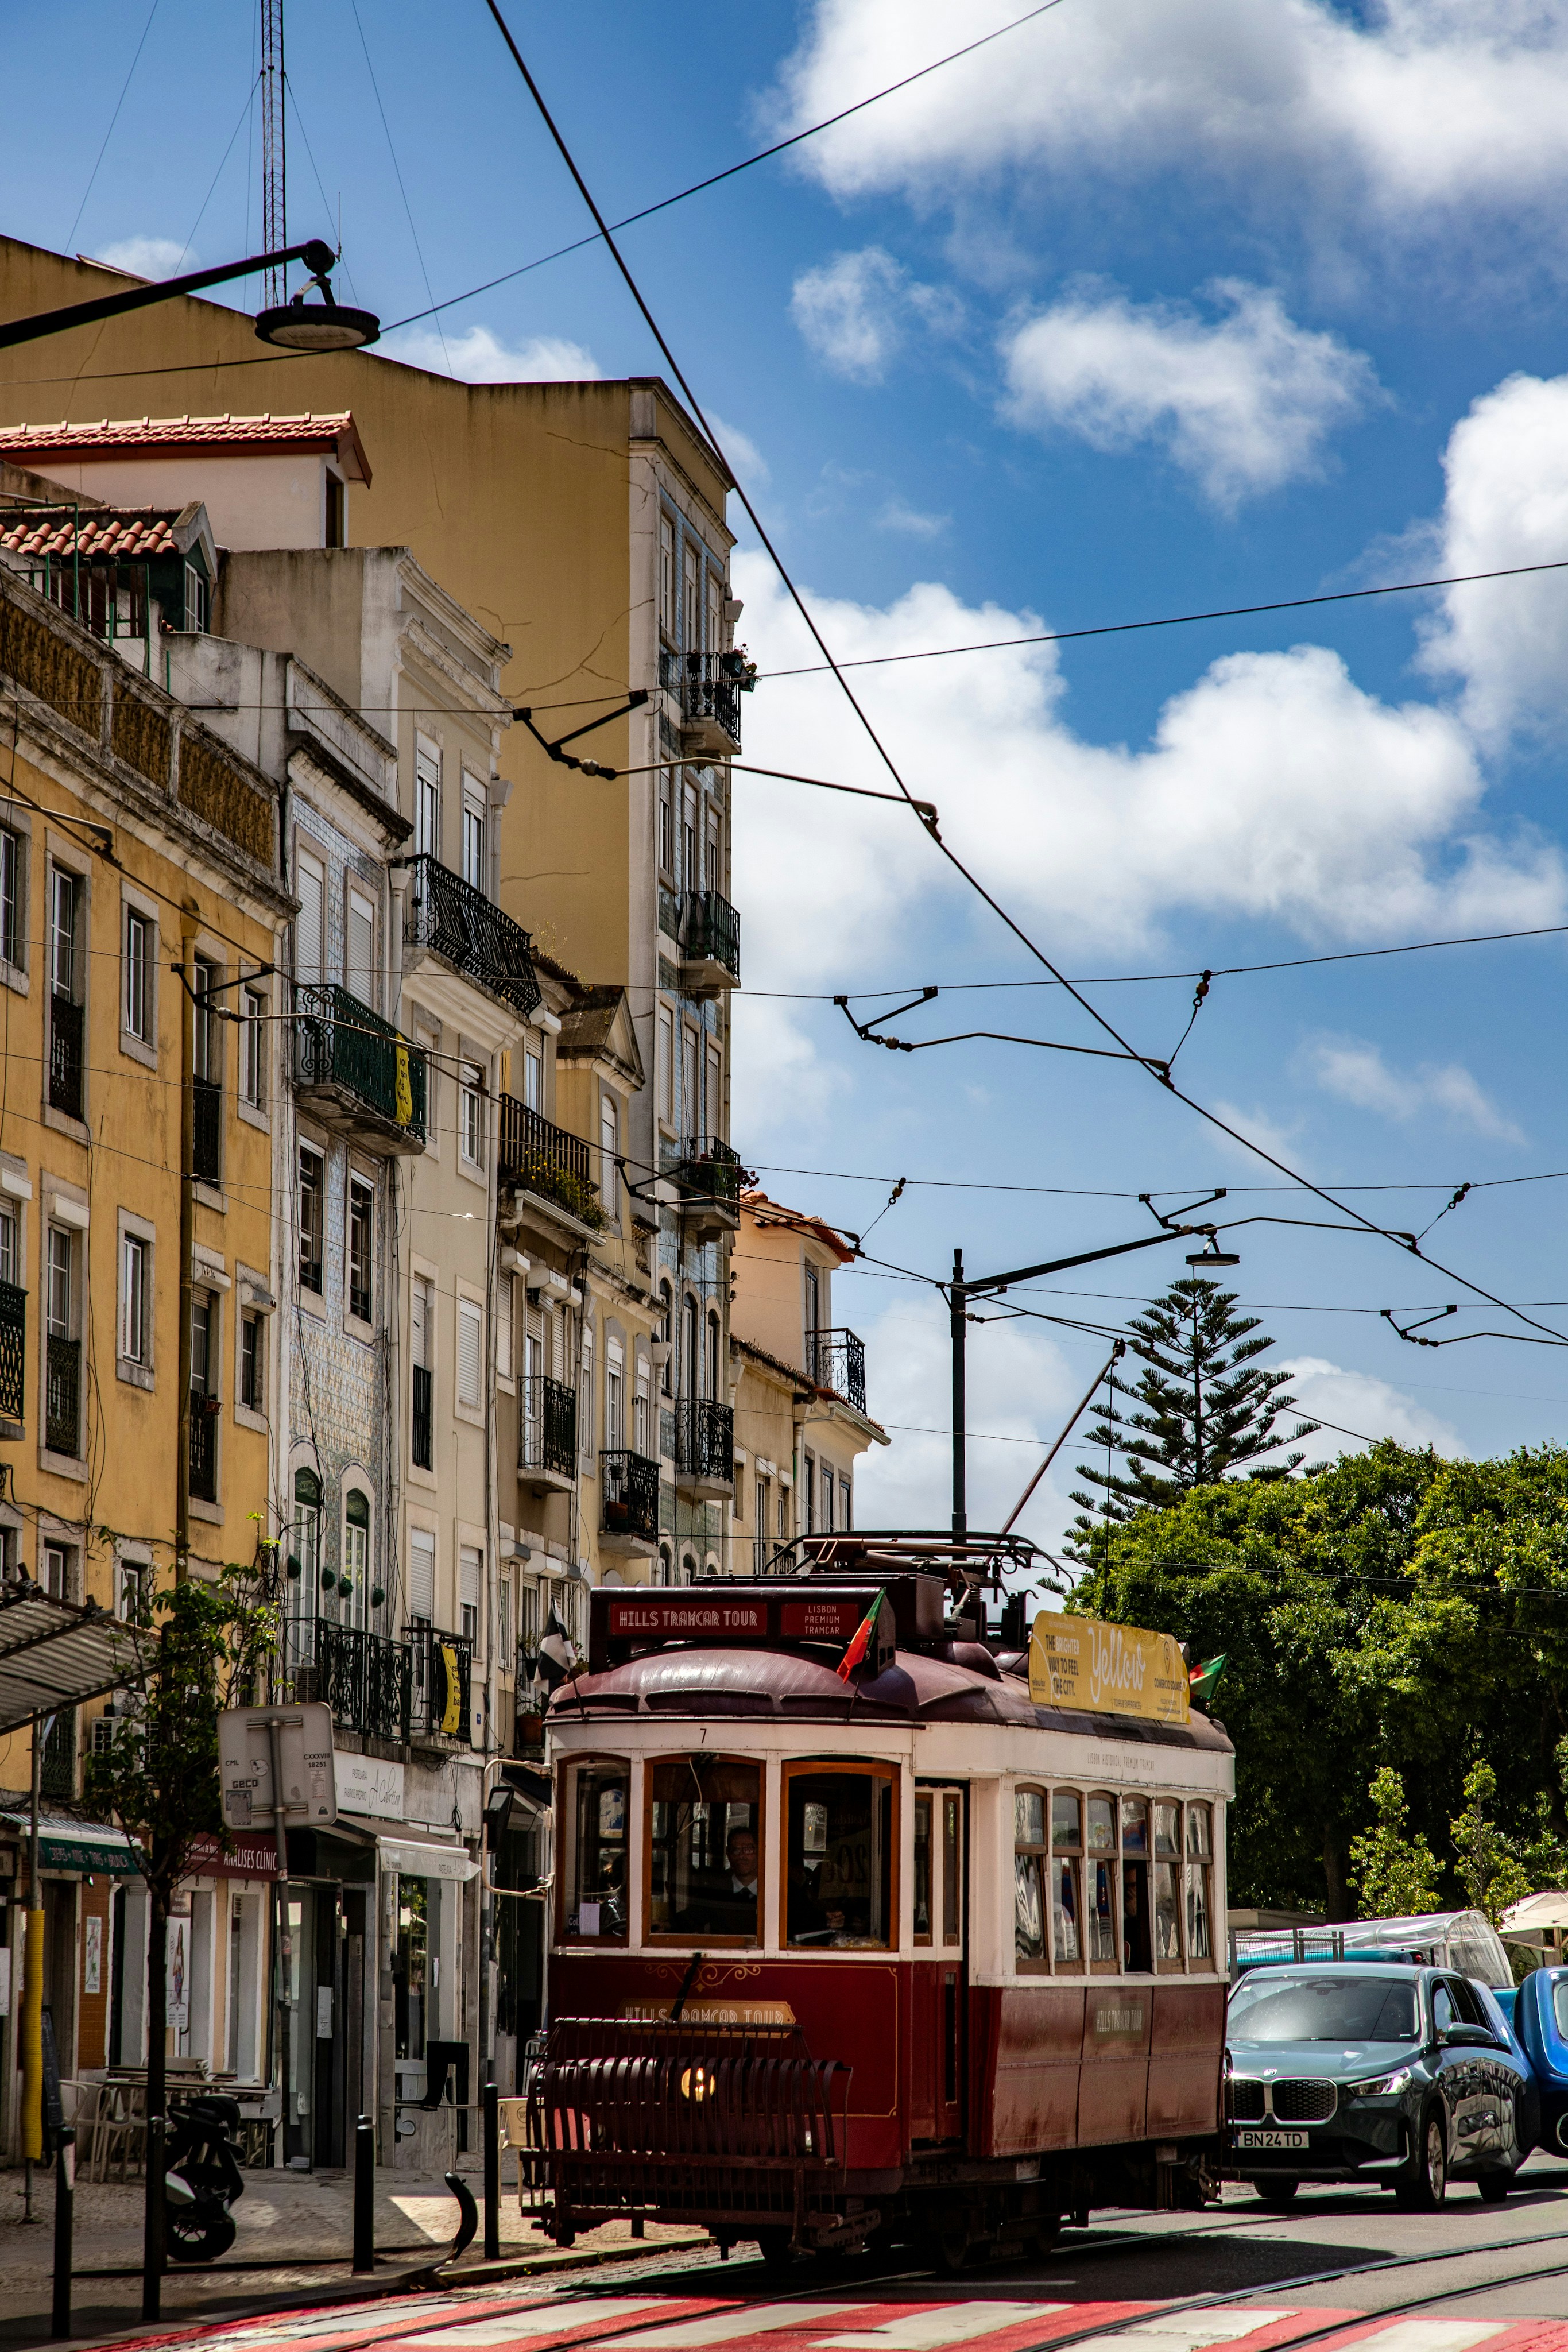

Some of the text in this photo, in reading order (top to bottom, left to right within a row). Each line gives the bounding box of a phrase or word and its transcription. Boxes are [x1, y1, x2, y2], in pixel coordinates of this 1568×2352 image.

[808, 1606, 837, 1614] LISBON
[620, 1611, 757, 1626] HILLS TRAMCAR TOUR
[804, 1615, 840, 1624] PREMIUM
[804, 1626, 839, 1634] TRAMCAR
[1046, 1634, 1080, 1655] THE BRIGHTER
[1048, 1656, 1079, 1676] WAY TO FEEL
[1087, 1627, 1146, 1704] Yellow
[1053, 1678, 1063, 1695] THE
[700, 1728, 707, 1744] 7
[1097, 2010, 1111, 2032] HILLS
[1244, 2133, 1302, 2146] BN 24 TD
